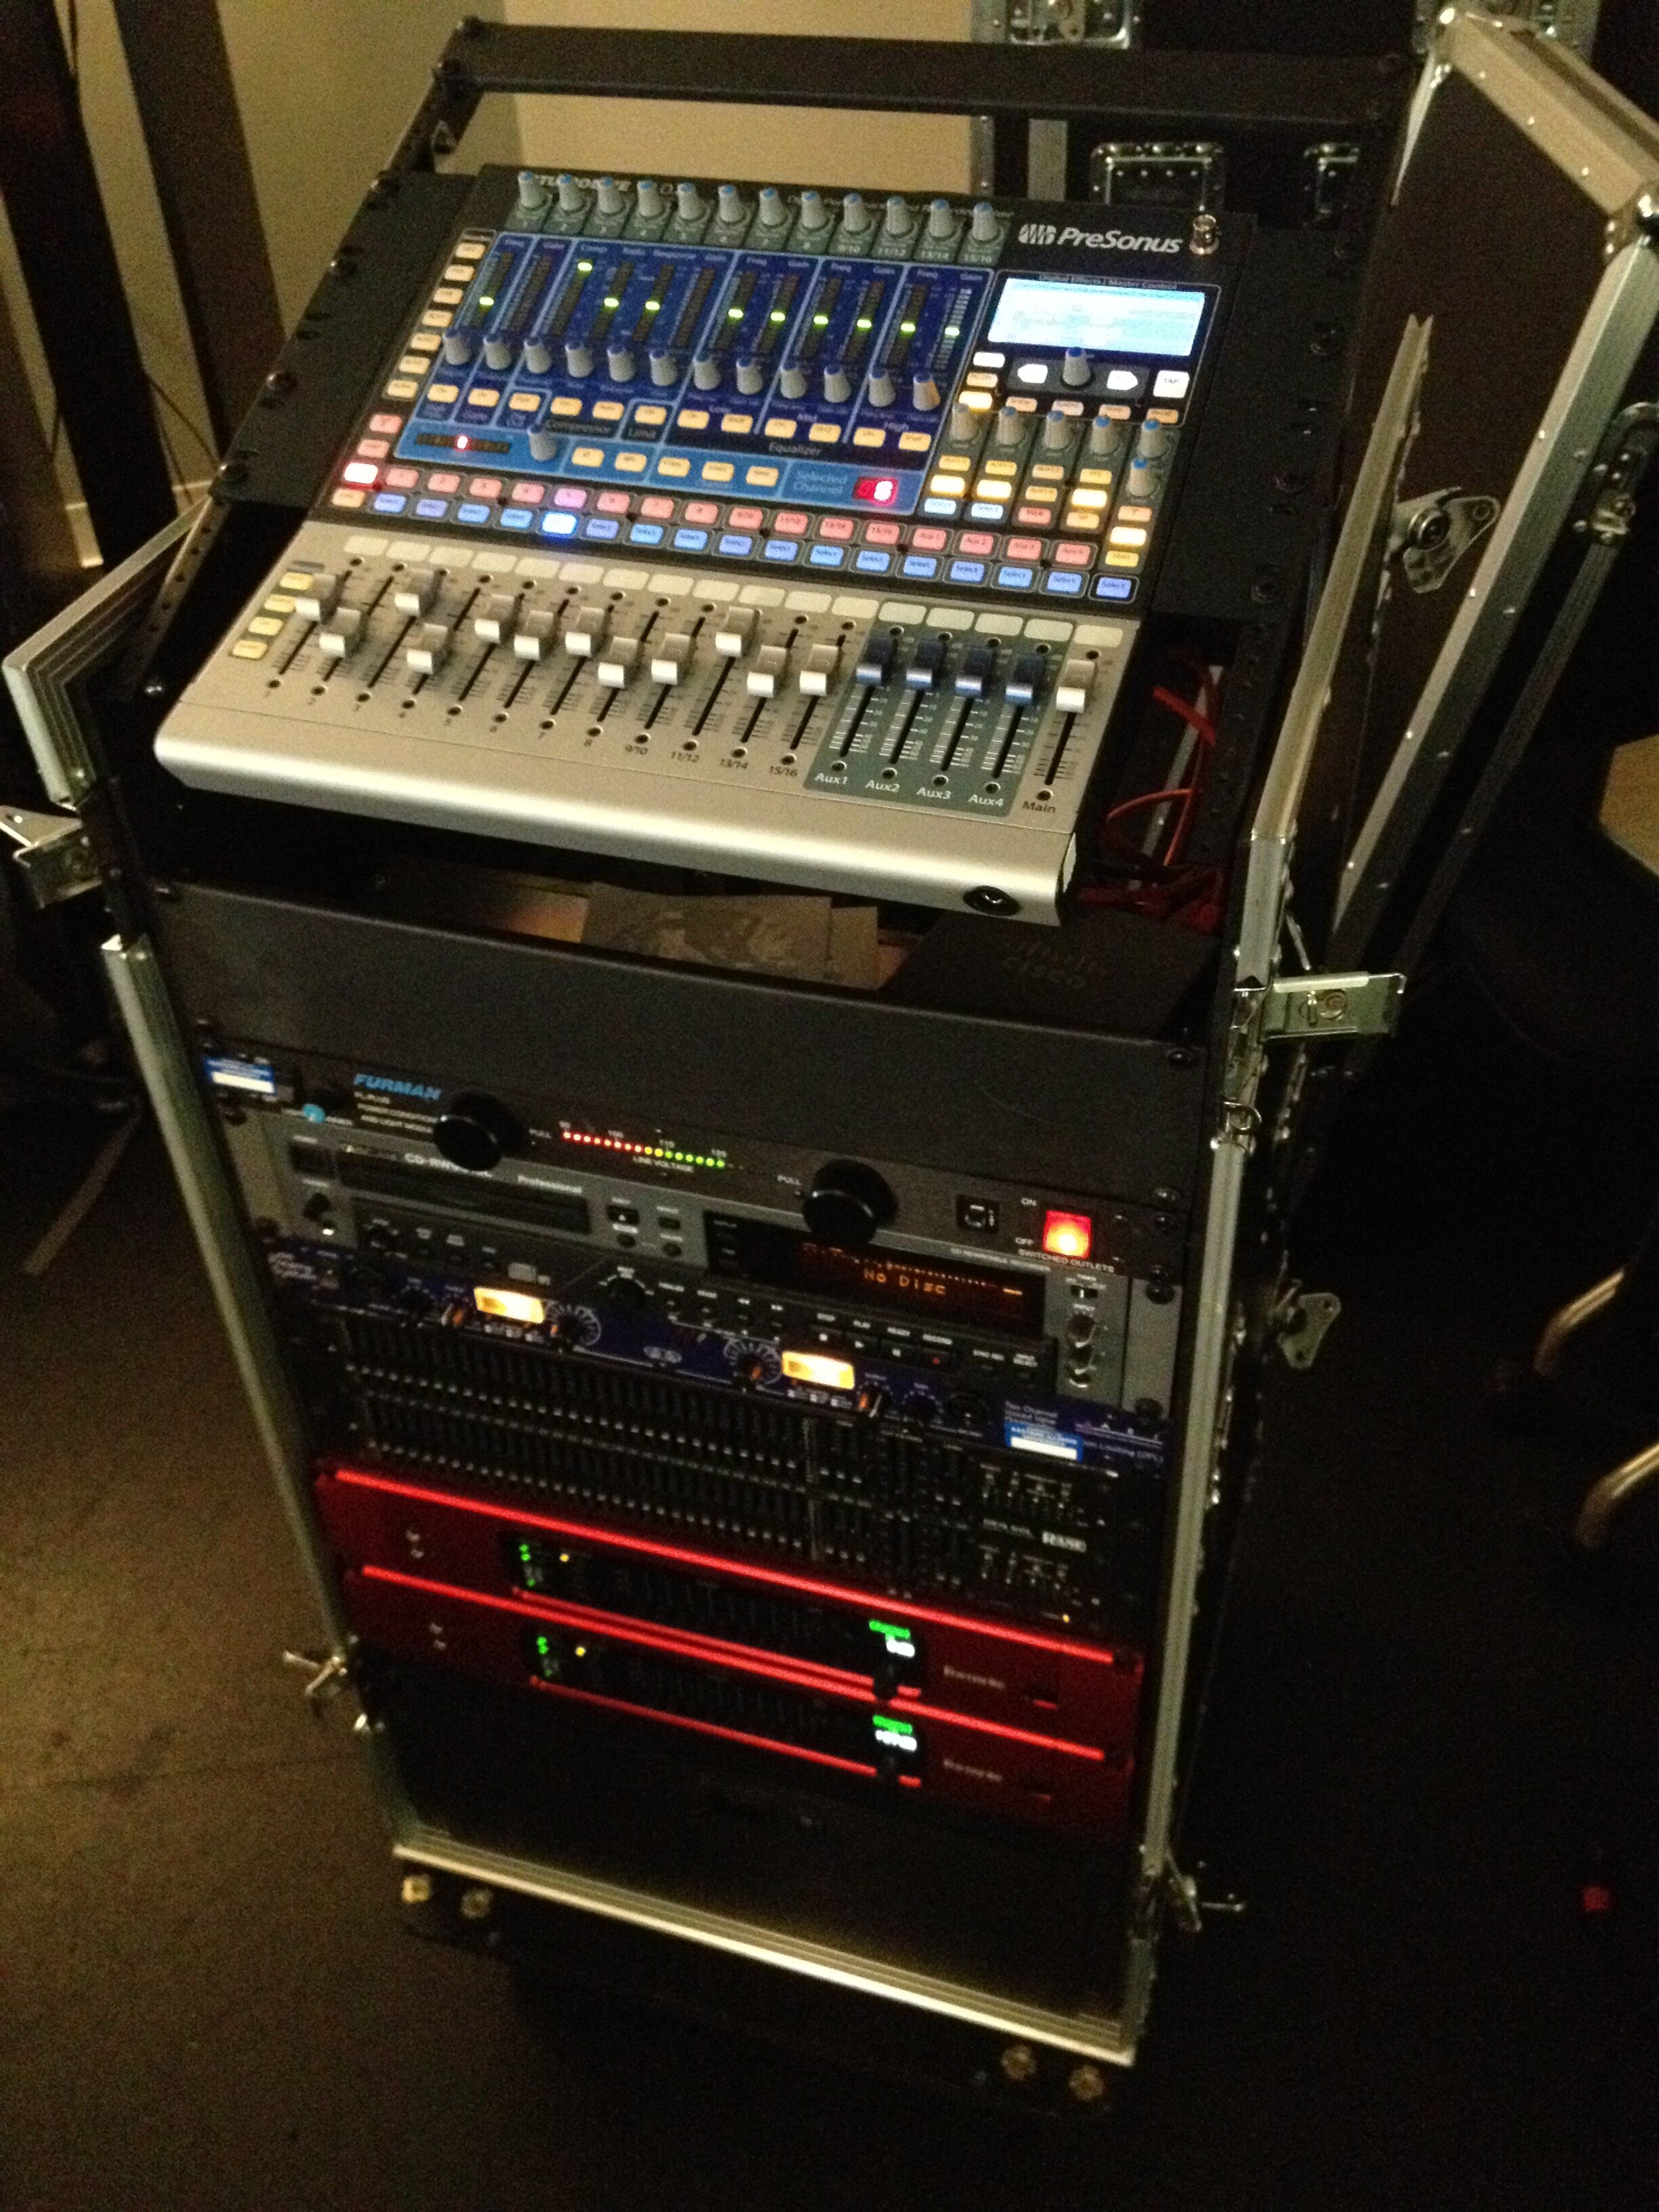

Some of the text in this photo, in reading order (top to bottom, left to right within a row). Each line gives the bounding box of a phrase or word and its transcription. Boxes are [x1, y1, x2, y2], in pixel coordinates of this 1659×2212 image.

[1057, 226, 1183, 253] PreSonus
[625, 744, 649, 756] 9/10
[670, 751, 700, 763] 11/12
[720, 758, 749, 770] 13/14
[769, 765, 798, 778] 15/16
[815, 771, 848, 785] Aux1
[865, 779, 900, 793] Aux2
[916, 785, 951, 800] Aux3
[967, 792, 1004, 808] Aux4
[1022, 800, 1056, 814] Main
[354, 1072, 442, 1101] FURMAN
[1021, 1197, 1037, 1207] ON
[1015, 1236, 1035, 1247] OFF
[1018, 1248, 1069, 1265] SWITCHED
[1070, 1258, 1115, 1273] OUTLETS
